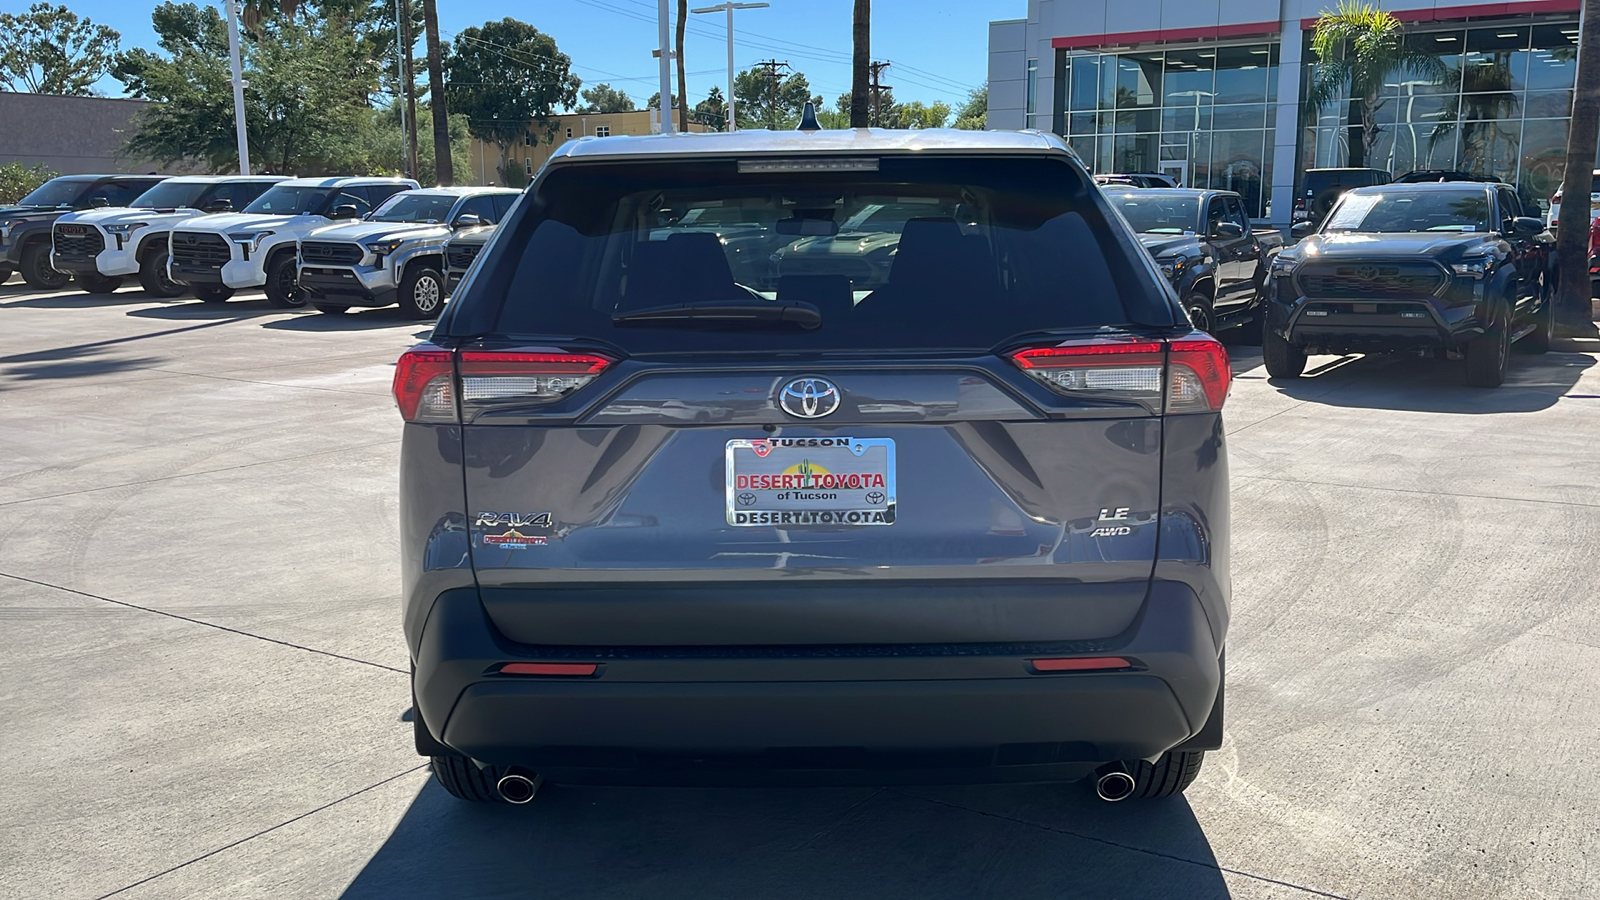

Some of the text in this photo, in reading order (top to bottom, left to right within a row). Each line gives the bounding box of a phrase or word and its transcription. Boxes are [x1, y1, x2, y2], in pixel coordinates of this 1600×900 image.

[770, 438, 850, 447] TUCSON
[737, 474, 885, 489] DESERT TOYOTA
[777, 491, 837, 500] of Tucson
[475, 511, 553, 528] RAV4
[735, 511, 885, 524] DESERT TOYOTA
[1097, 507, 1130, 521] LE
[1089, 526, 1131, 538] AWD
